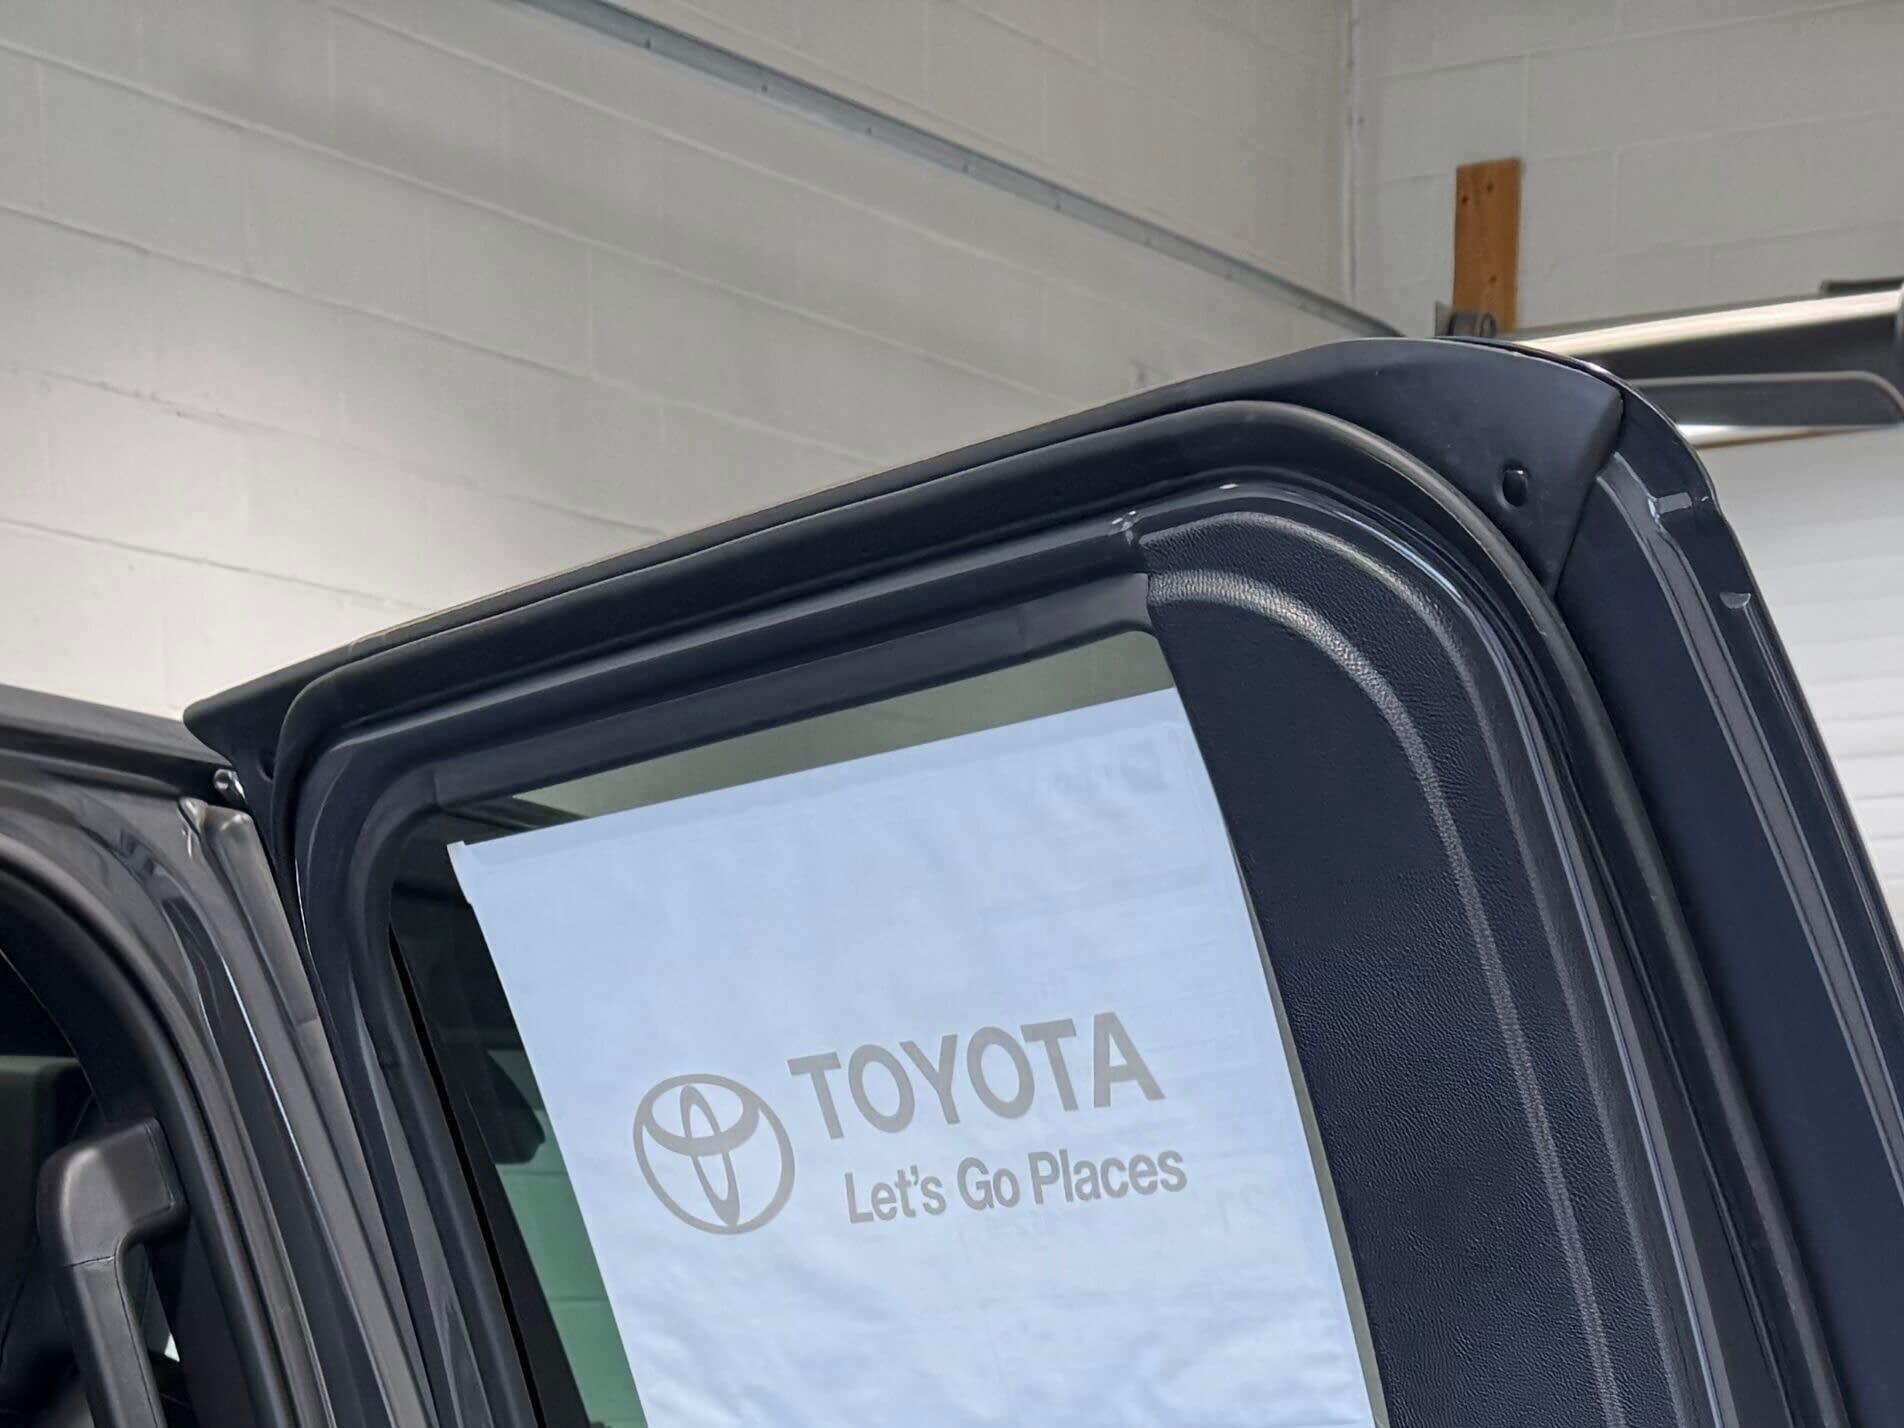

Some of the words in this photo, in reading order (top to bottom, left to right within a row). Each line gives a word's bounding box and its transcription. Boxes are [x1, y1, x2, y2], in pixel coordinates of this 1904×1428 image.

[787, 1011, 1167, 1140] TOYOTA
[845, 1164, 947, 1224] Let's
[956, 1156, 1020, 1211] Go
[1027, 1148, 1188, 1205] Places
